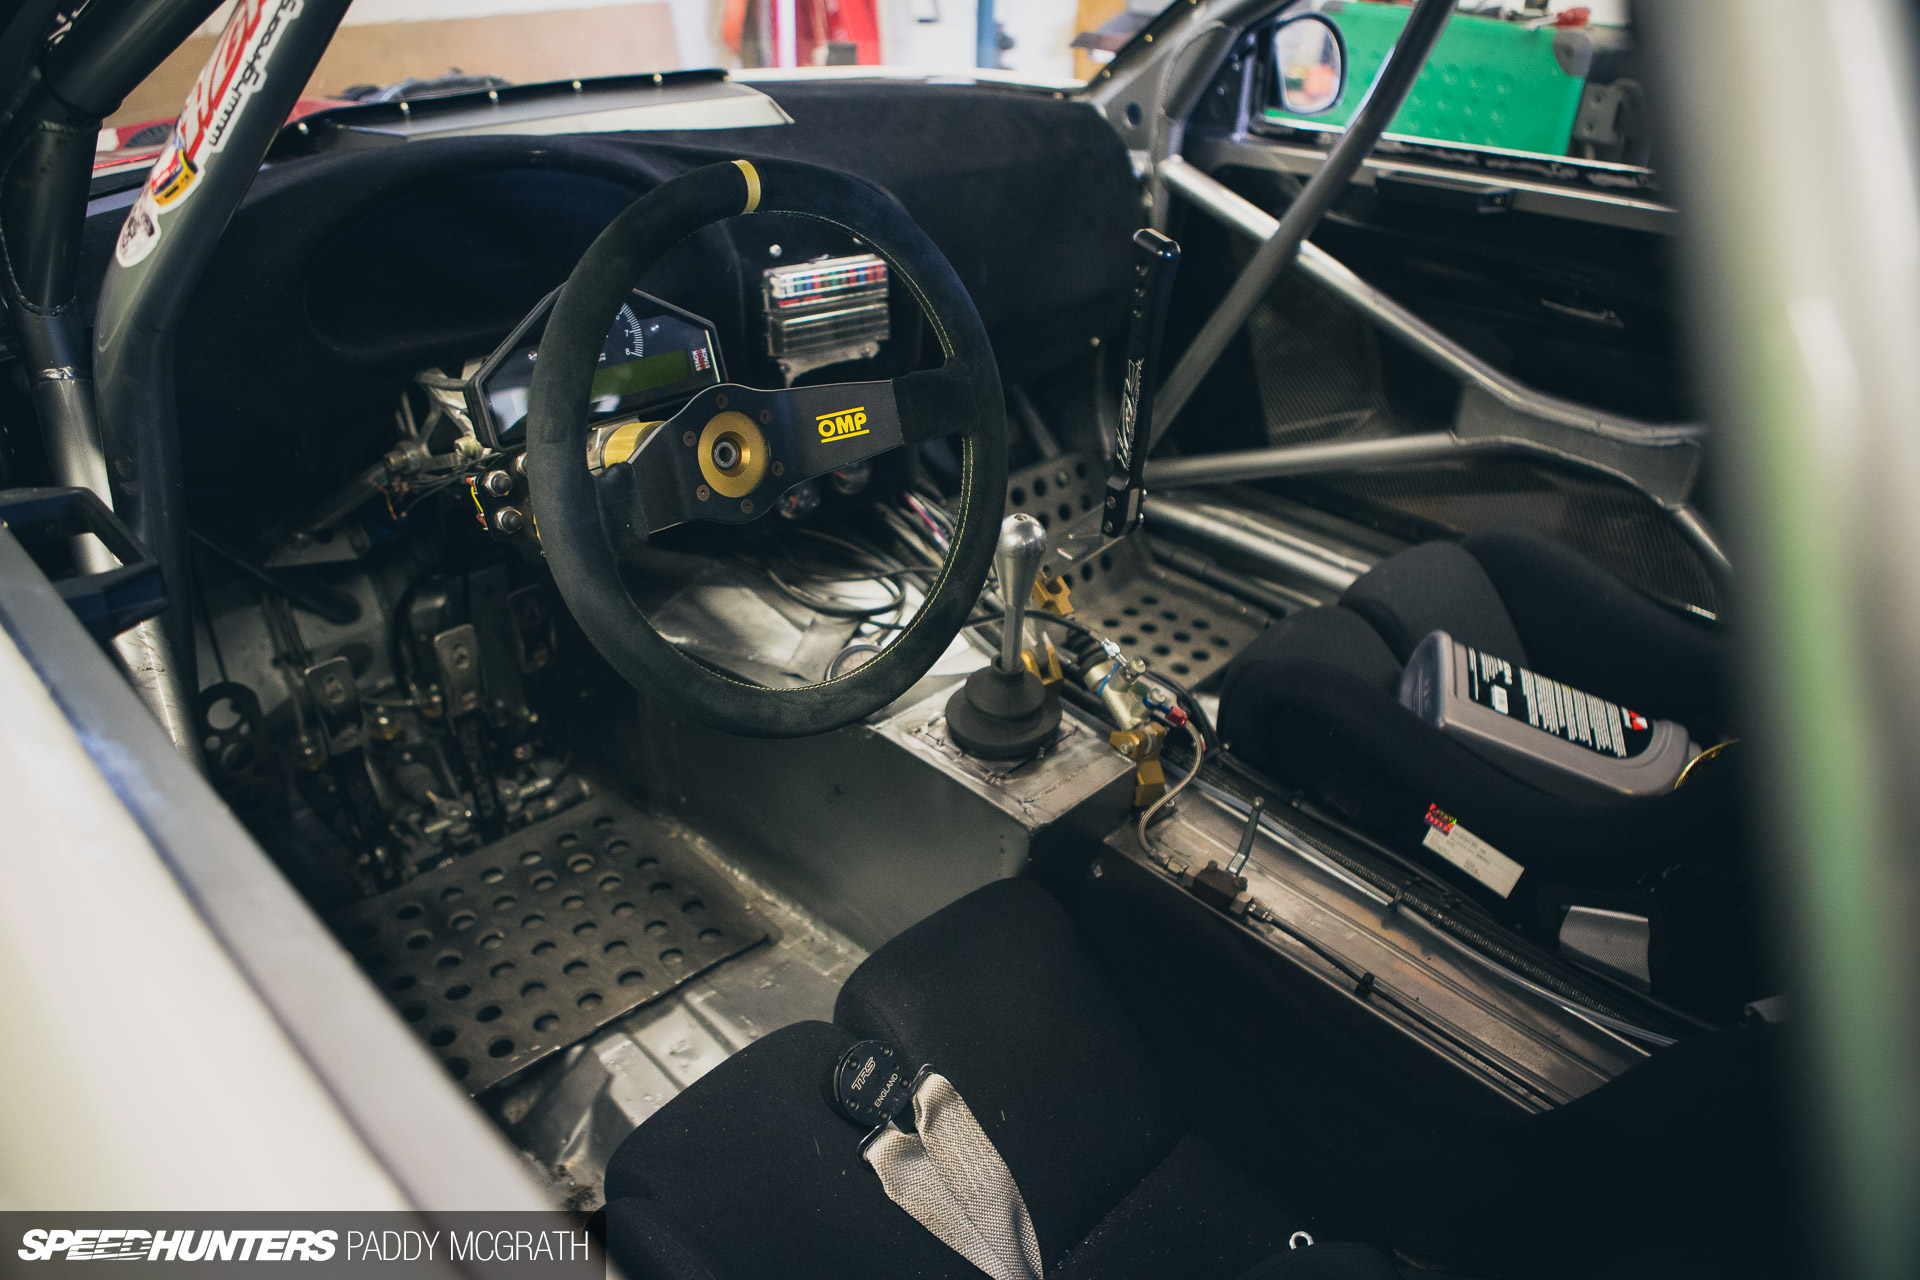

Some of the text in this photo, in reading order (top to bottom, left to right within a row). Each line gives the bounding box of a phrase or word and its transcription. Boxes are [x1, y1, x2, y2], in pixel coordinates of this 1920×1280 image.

[818, 412, 867, 437] OMP
[851, 1056, 876, 1090] TRS
[874, 1073, 898, 1107] ENGLAND
